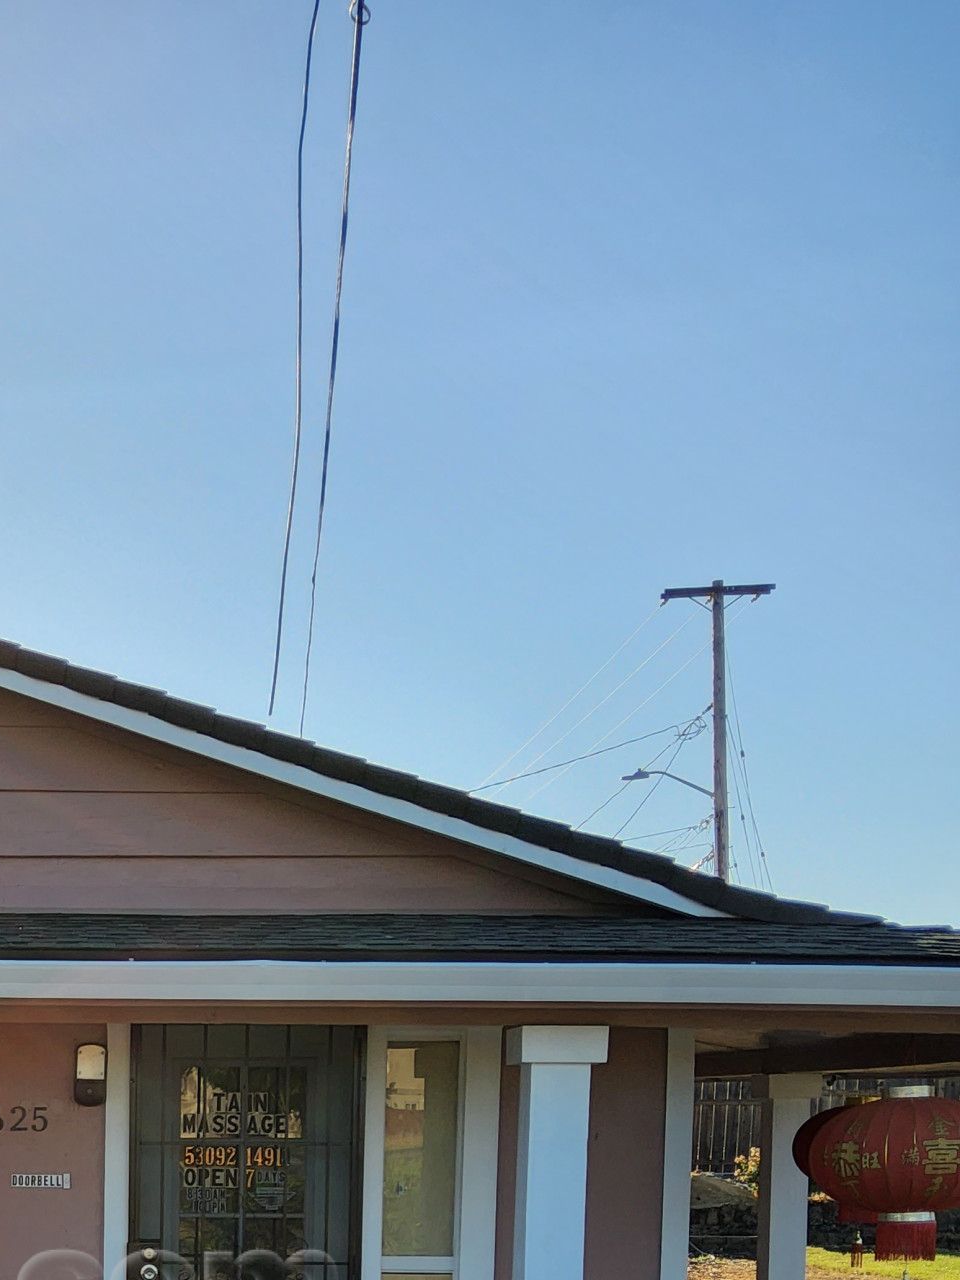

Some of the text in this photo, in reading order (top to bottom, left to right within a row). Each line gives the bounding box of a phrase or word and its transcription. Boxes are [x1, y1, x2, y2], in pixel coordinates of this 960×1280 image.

[182, 1113, 288, 1134] MASSAGE
[922, 1137, 960, 1176] 喜
[12, 1174, 63, 1187] DOORBELL
[184, 1168, 287, 1188] OPEN 7 DAYS
